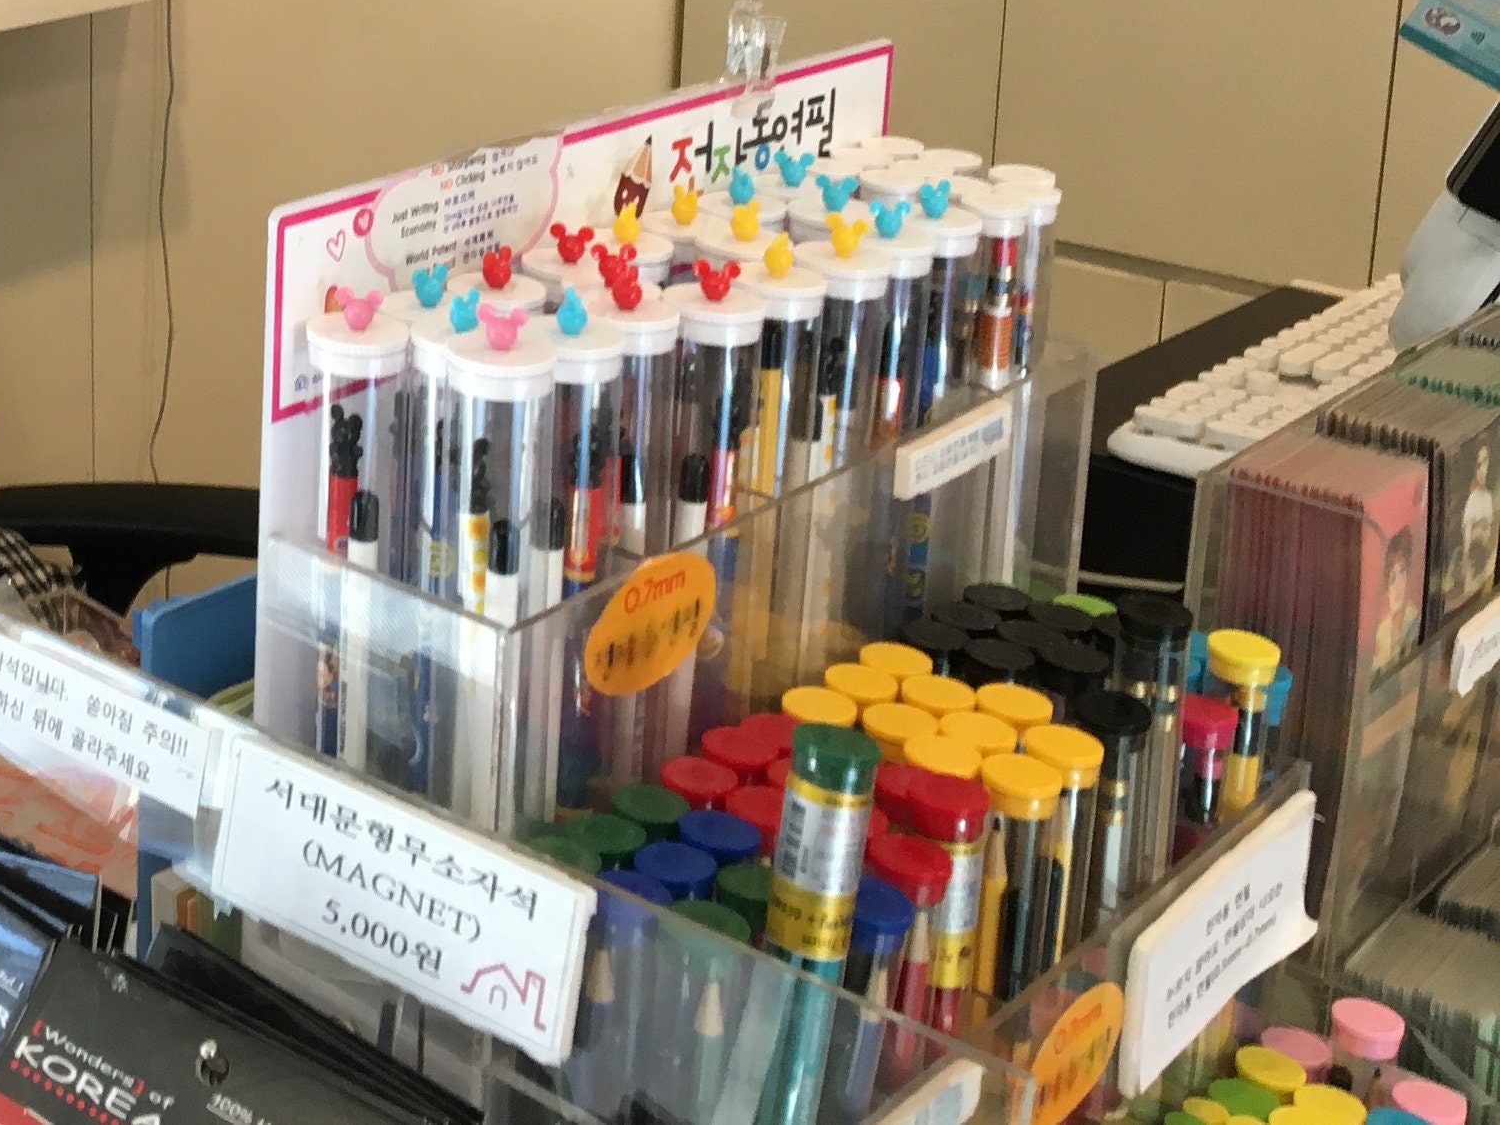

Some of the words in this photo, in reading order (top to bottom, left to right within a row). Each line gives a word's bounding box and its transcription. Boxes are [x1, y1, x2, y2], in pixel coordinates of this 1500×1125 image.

[455, 170, 485, 187] Clicking
[411, 201, 439, 217] Writing
[401, 221, 437, 238] Economy
[431, 240, 457, 256] Patent
[624, 570, 686, 614] 0.7mm
[265, 777, 543, 921] 서대문형무소자석
[302, 837, 482, 943] (MAGNET)
